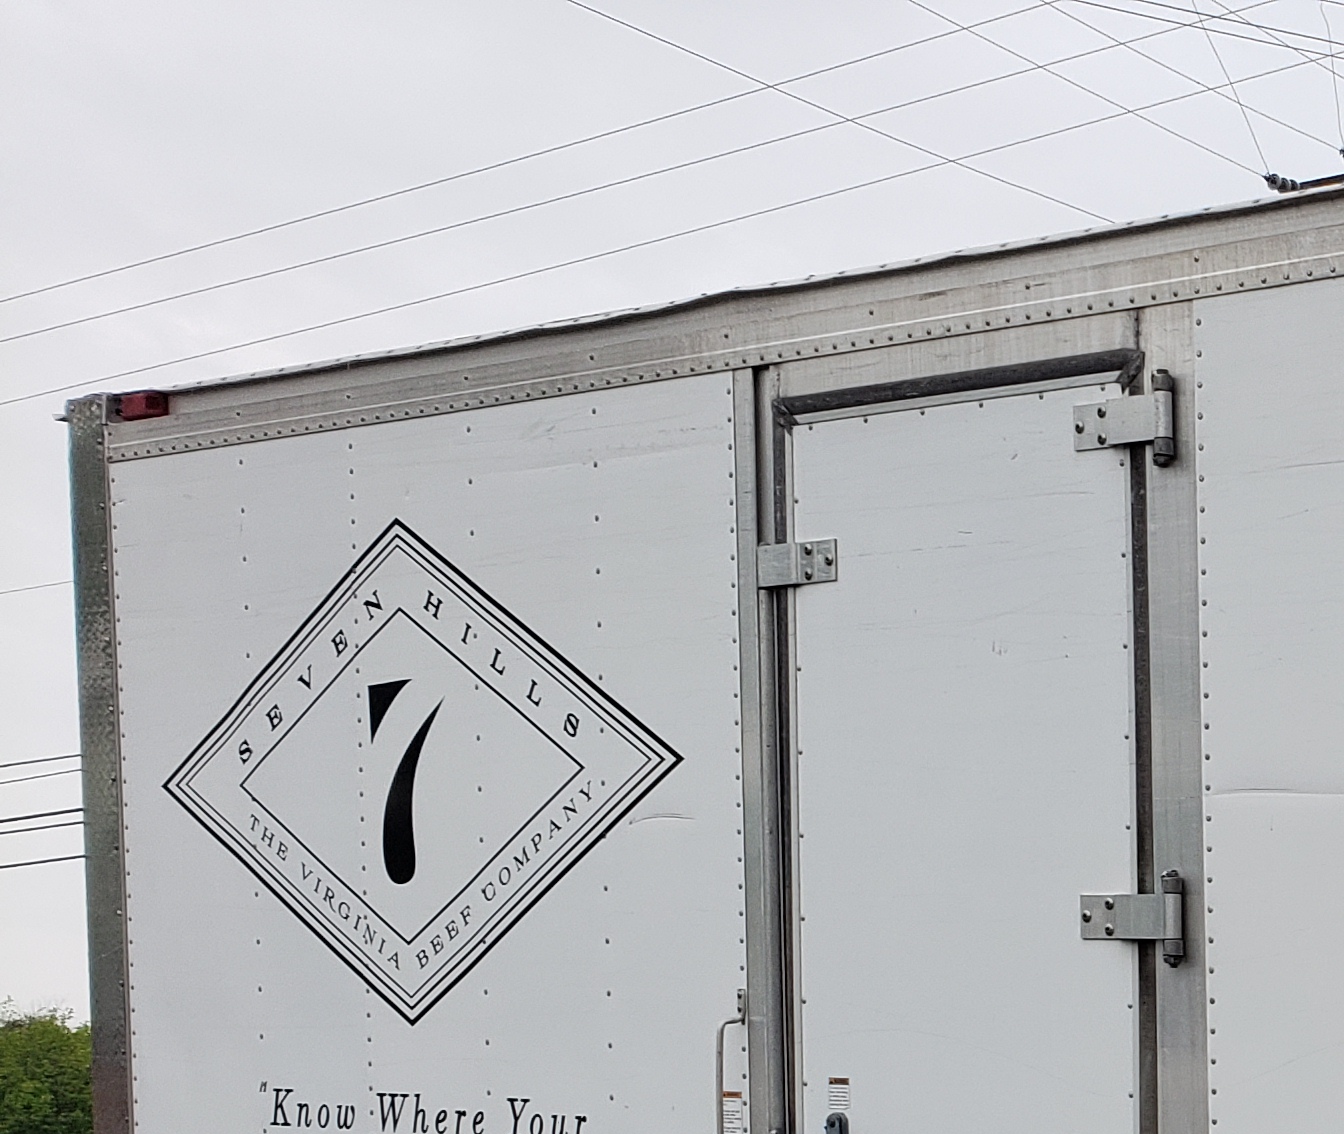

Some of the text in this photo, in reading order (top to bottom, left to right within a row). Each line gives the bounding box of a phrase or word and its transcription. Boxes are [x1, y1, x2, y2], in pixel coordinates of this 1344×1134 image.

[236, 590, 581, 763] SEVEN HILLS
[367, 678, 445, 885] 7
[250, 780, 593, 970] THE VIRGINIA BEEF COMPANY
[259, 1081, 355, 1130] "Know
